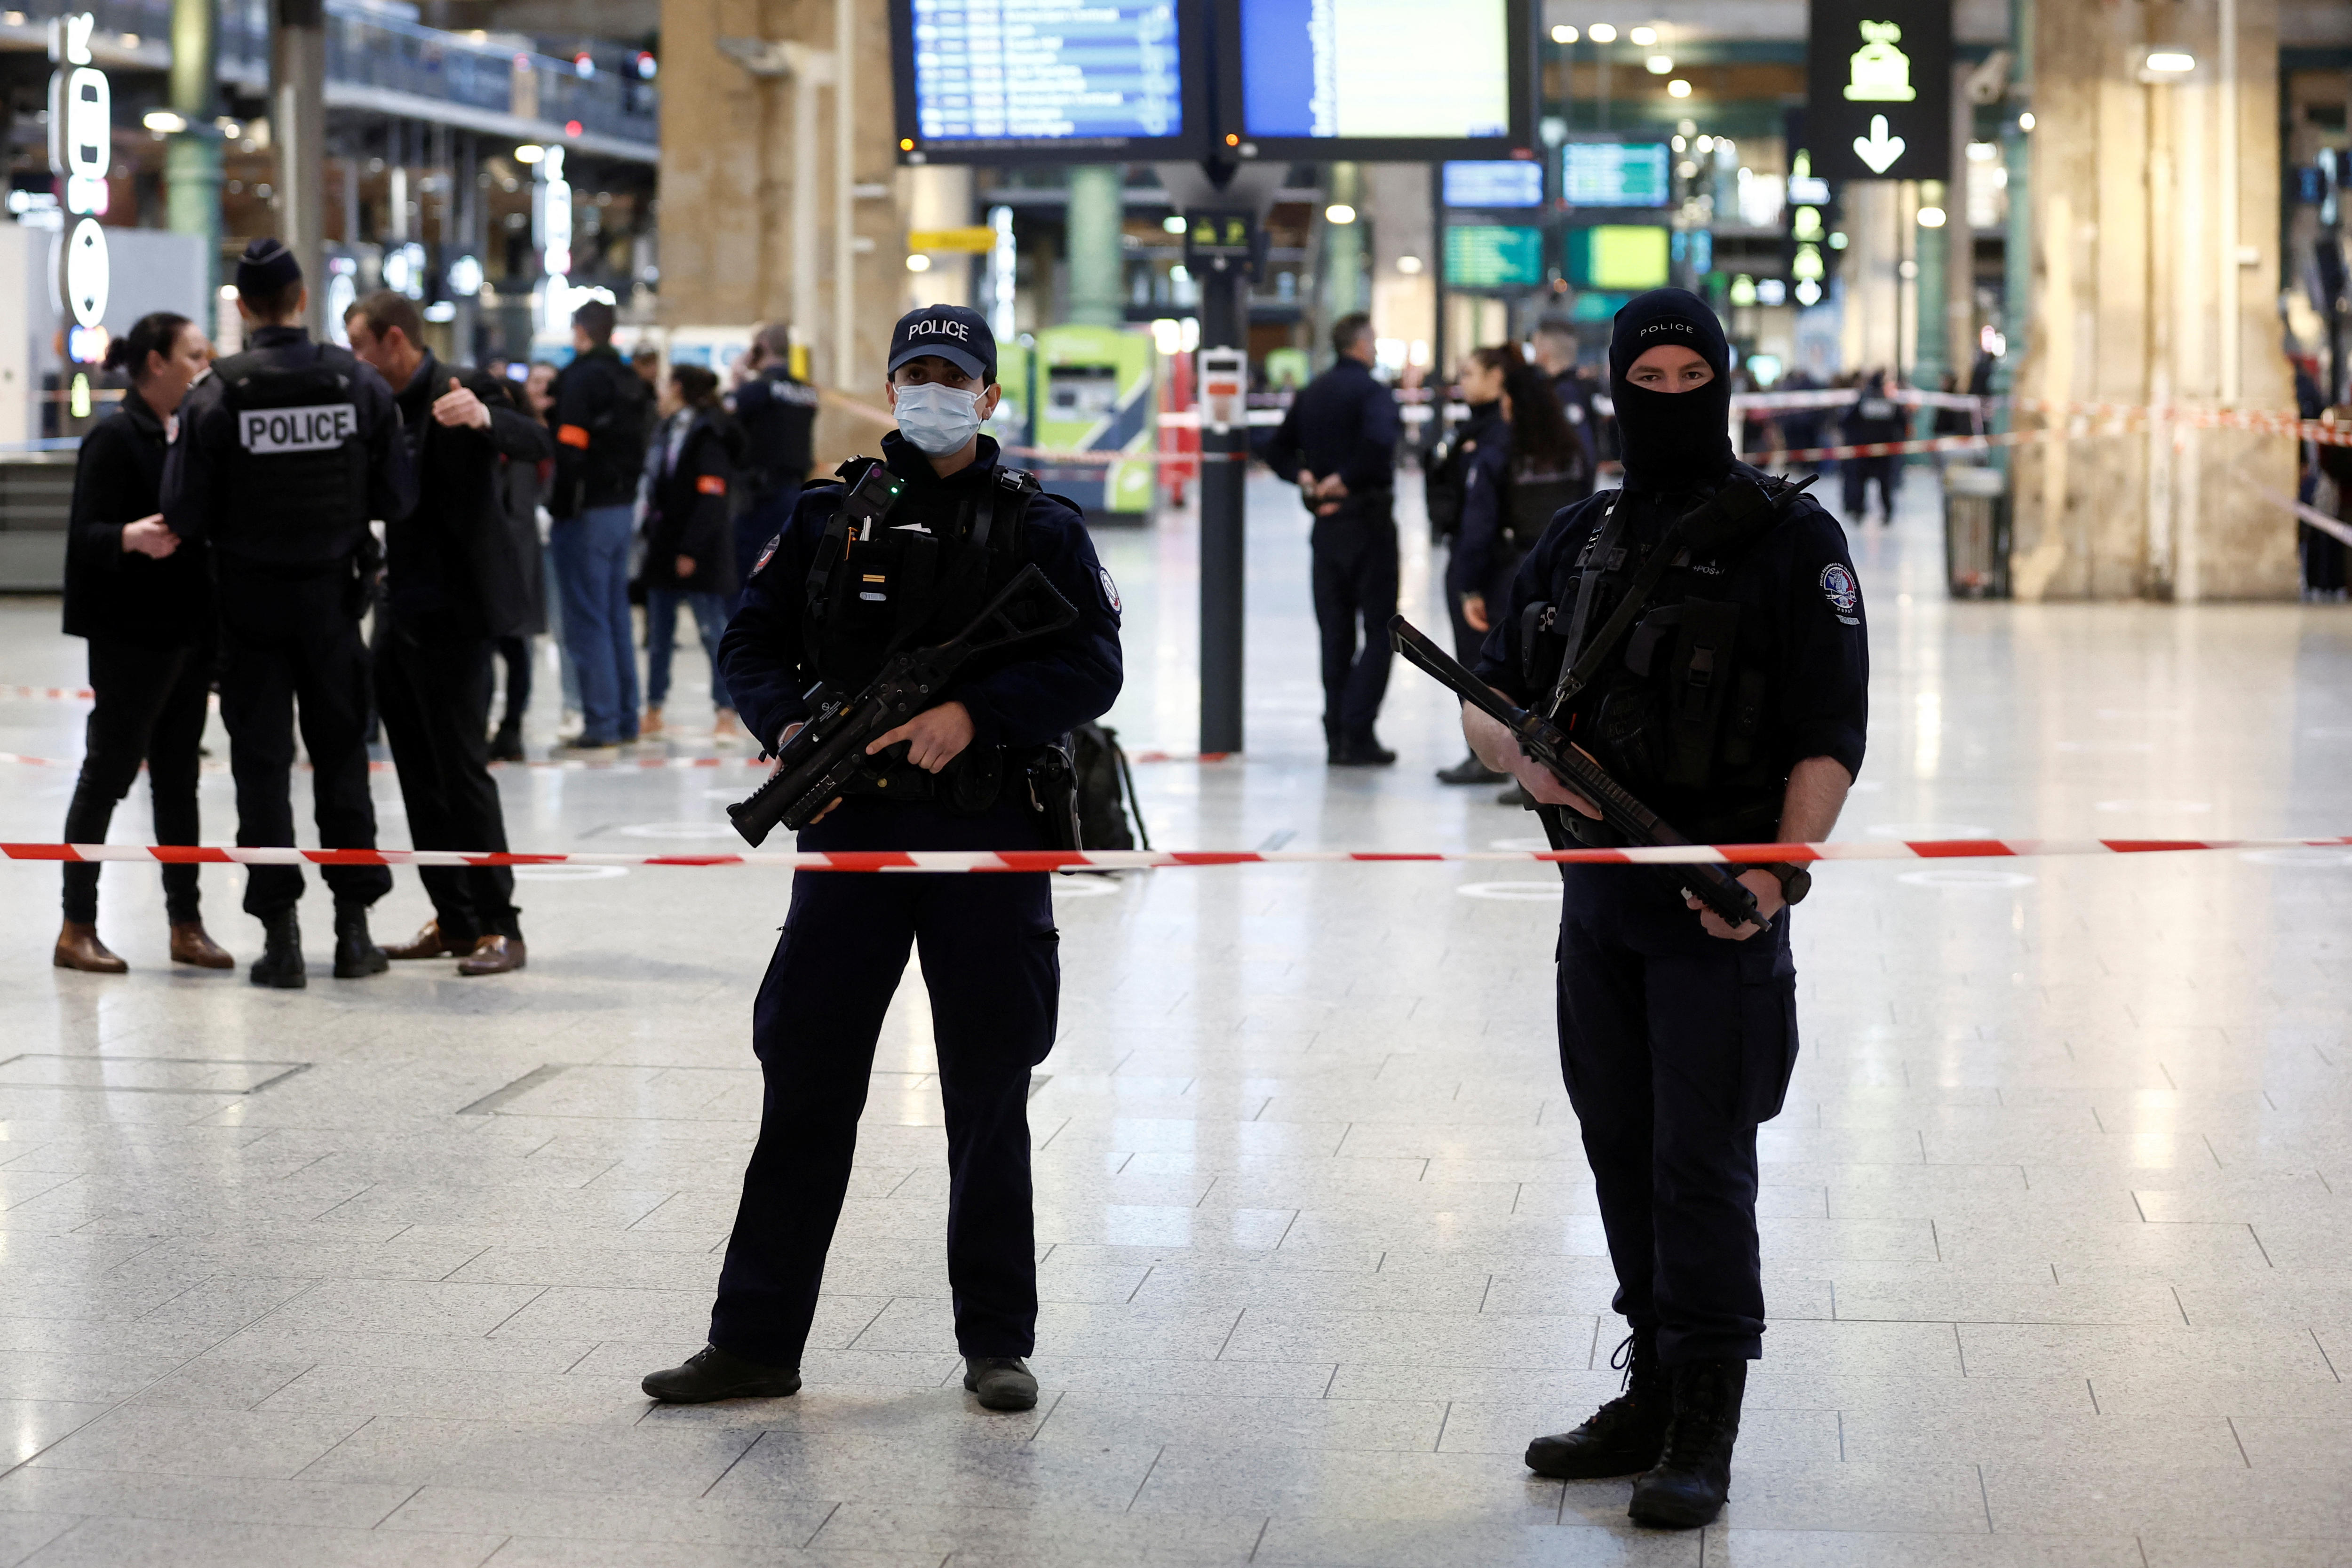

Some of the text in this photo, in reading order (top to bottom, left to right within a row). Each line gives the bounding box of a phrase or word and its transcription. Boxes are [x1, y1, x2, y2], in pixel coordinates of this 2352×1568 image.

[908, 319, 969, 342] POLICE
[1641, 323, 1693, 337] POLICE
[248, 412, 348, 446] POLICE
